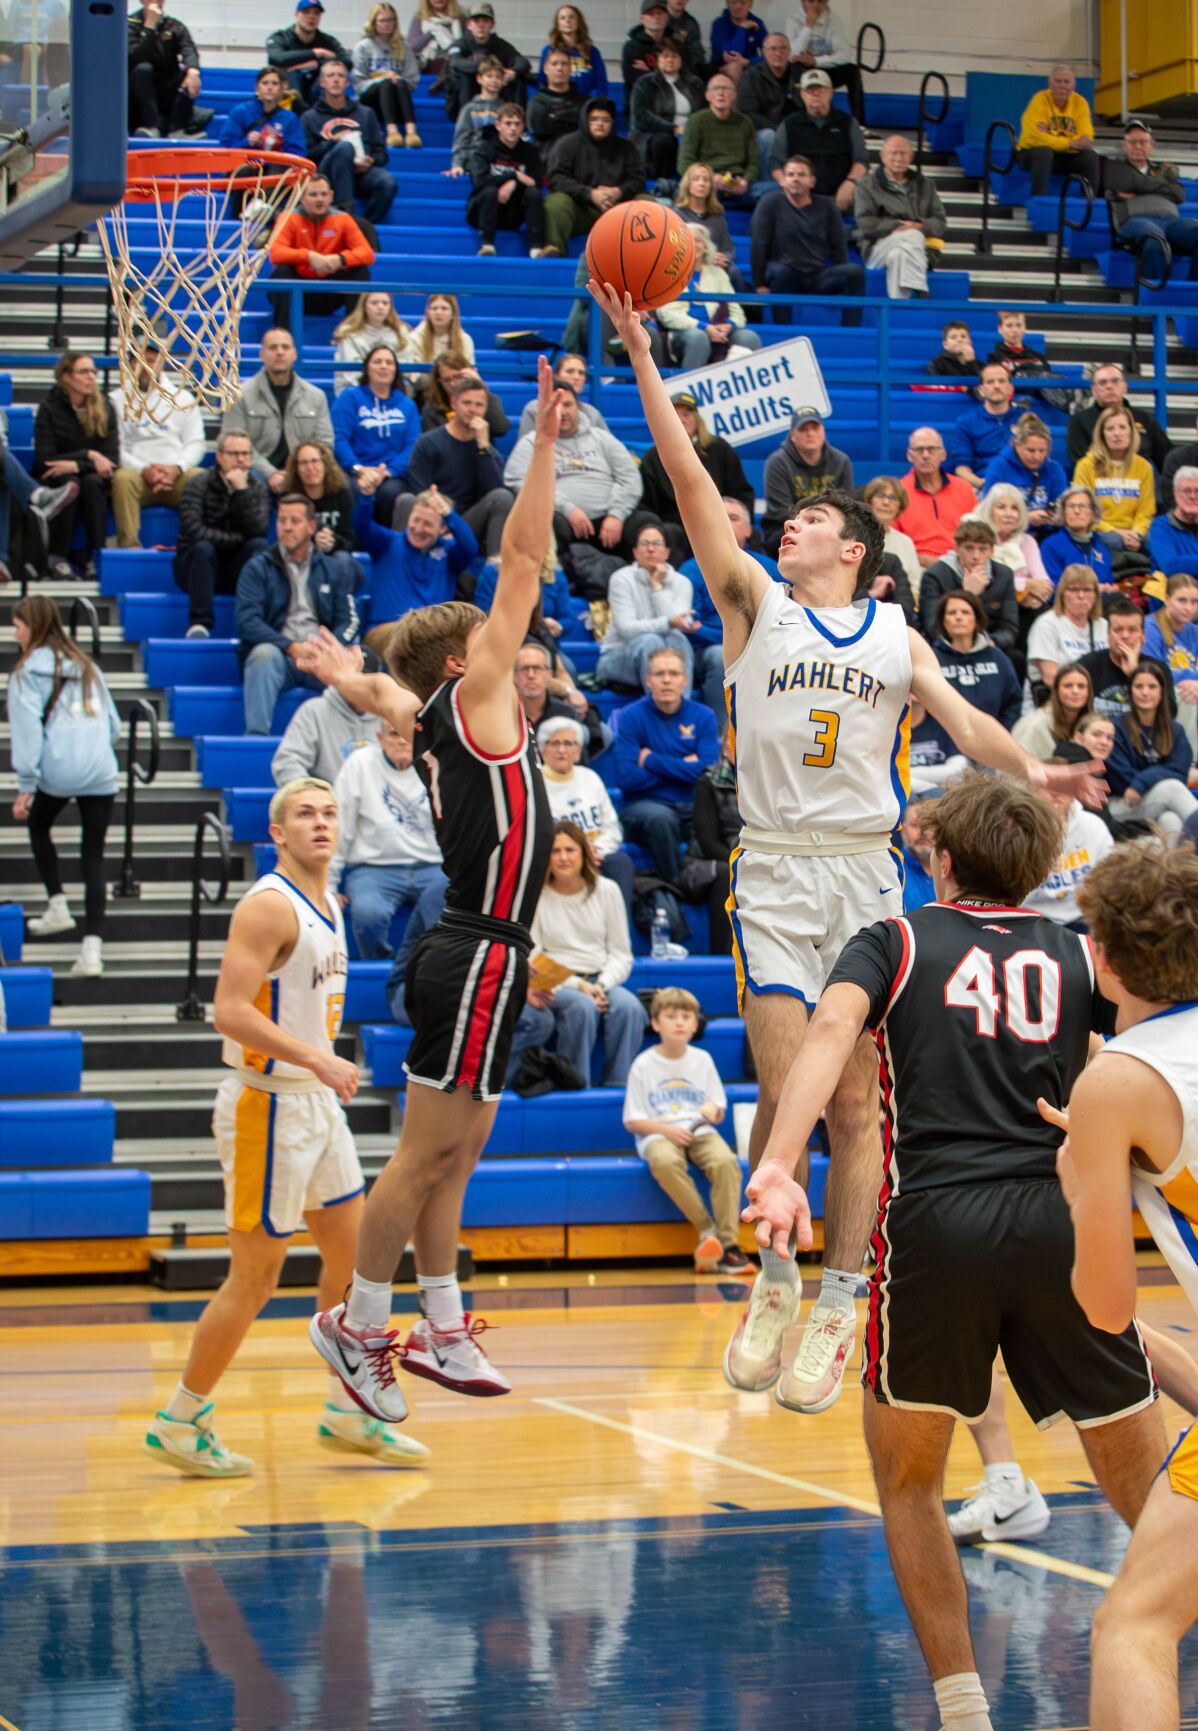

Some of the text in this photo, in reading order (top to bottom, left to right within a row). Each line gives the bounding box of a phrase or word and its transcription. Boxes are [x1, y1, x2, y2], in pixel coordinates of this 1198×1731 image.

[688, 356, 794, 407] Wahlert
[713, 395, 794, 436] Adults
[767, 661, 886, 709] WAHLERT
[802, 708, 841, 769] 3
[944, 944, 1062, 1044] 40
